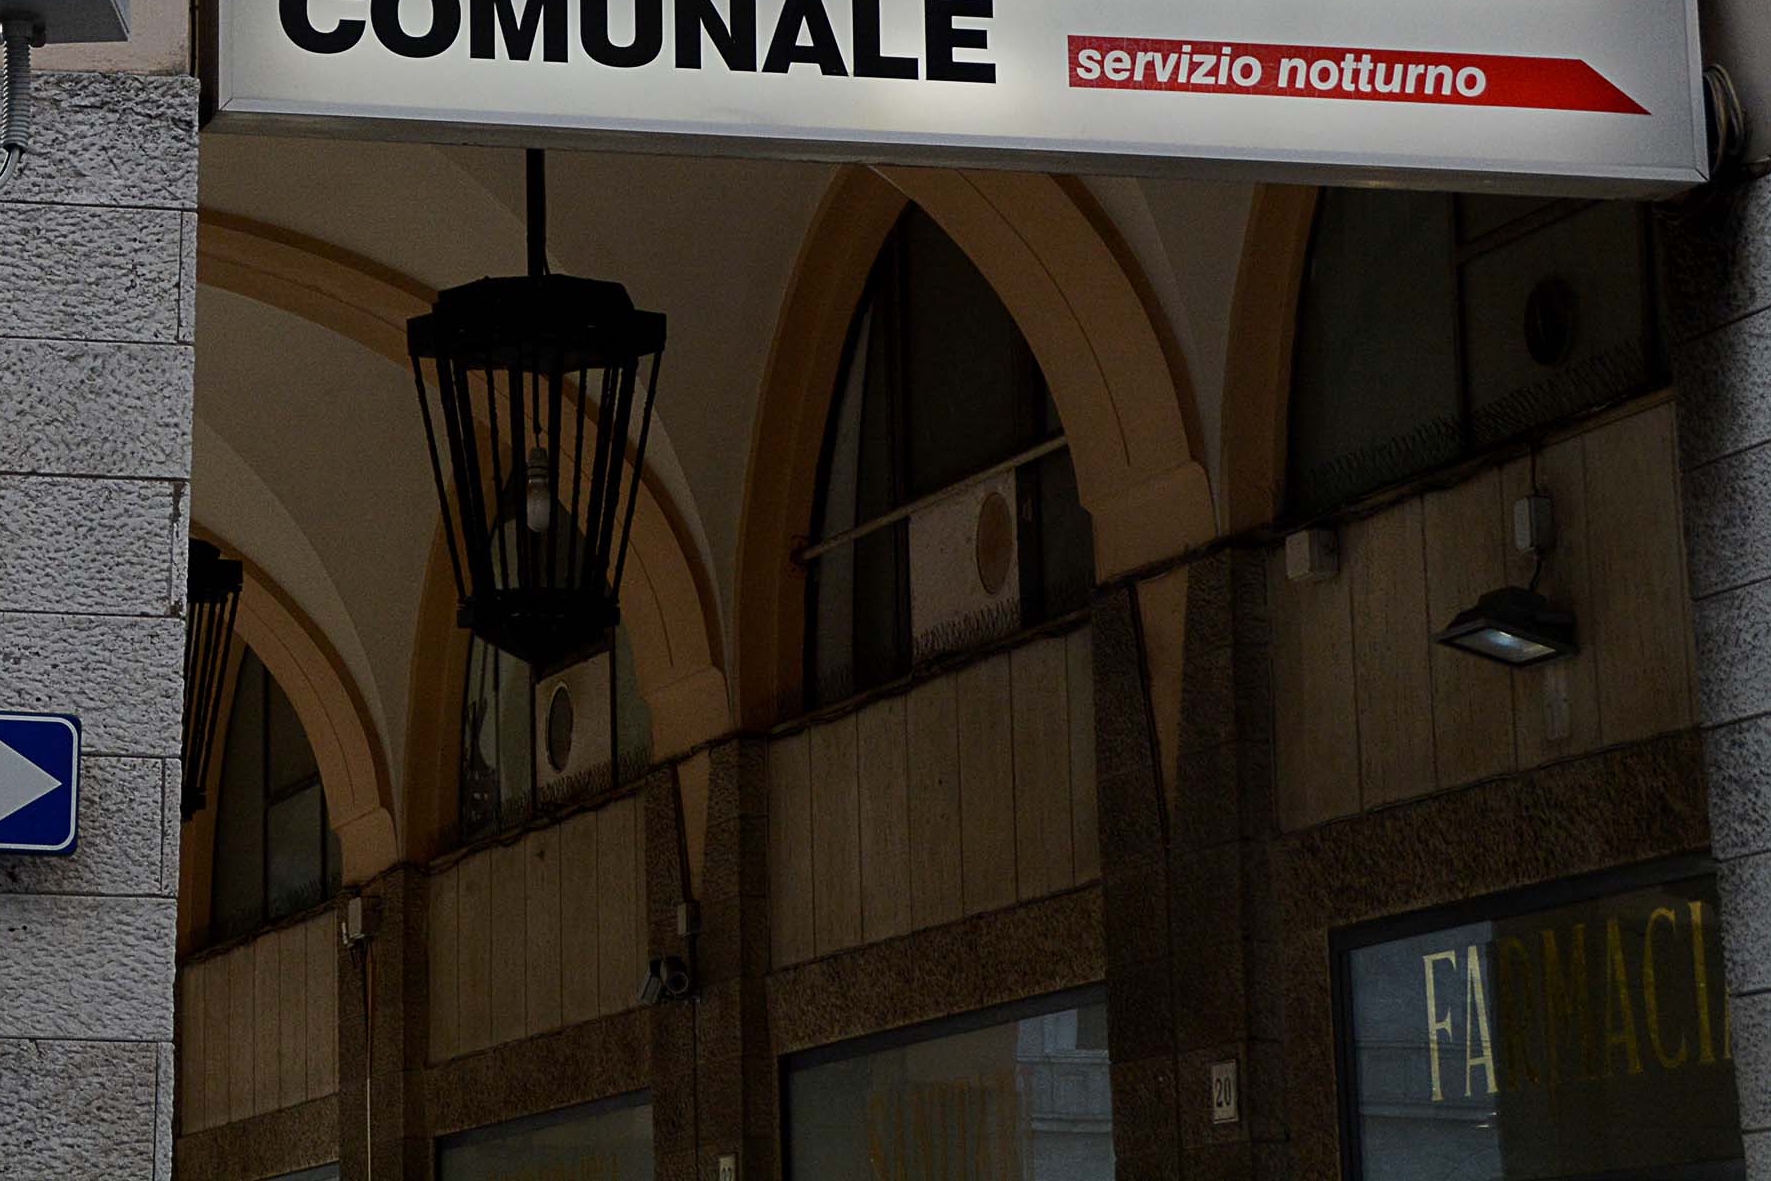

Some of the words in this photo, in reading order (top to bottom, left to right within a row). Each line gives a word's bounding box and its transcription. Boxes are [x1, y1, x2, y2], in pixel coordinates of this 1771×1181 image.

[1075, 44, 1263, 88] servizio
[1277, 52, 1486, 98] notturno
[1423, 899, 1733, 1100] FARMACI
[1215, 1077, 1231, 1107] 20
